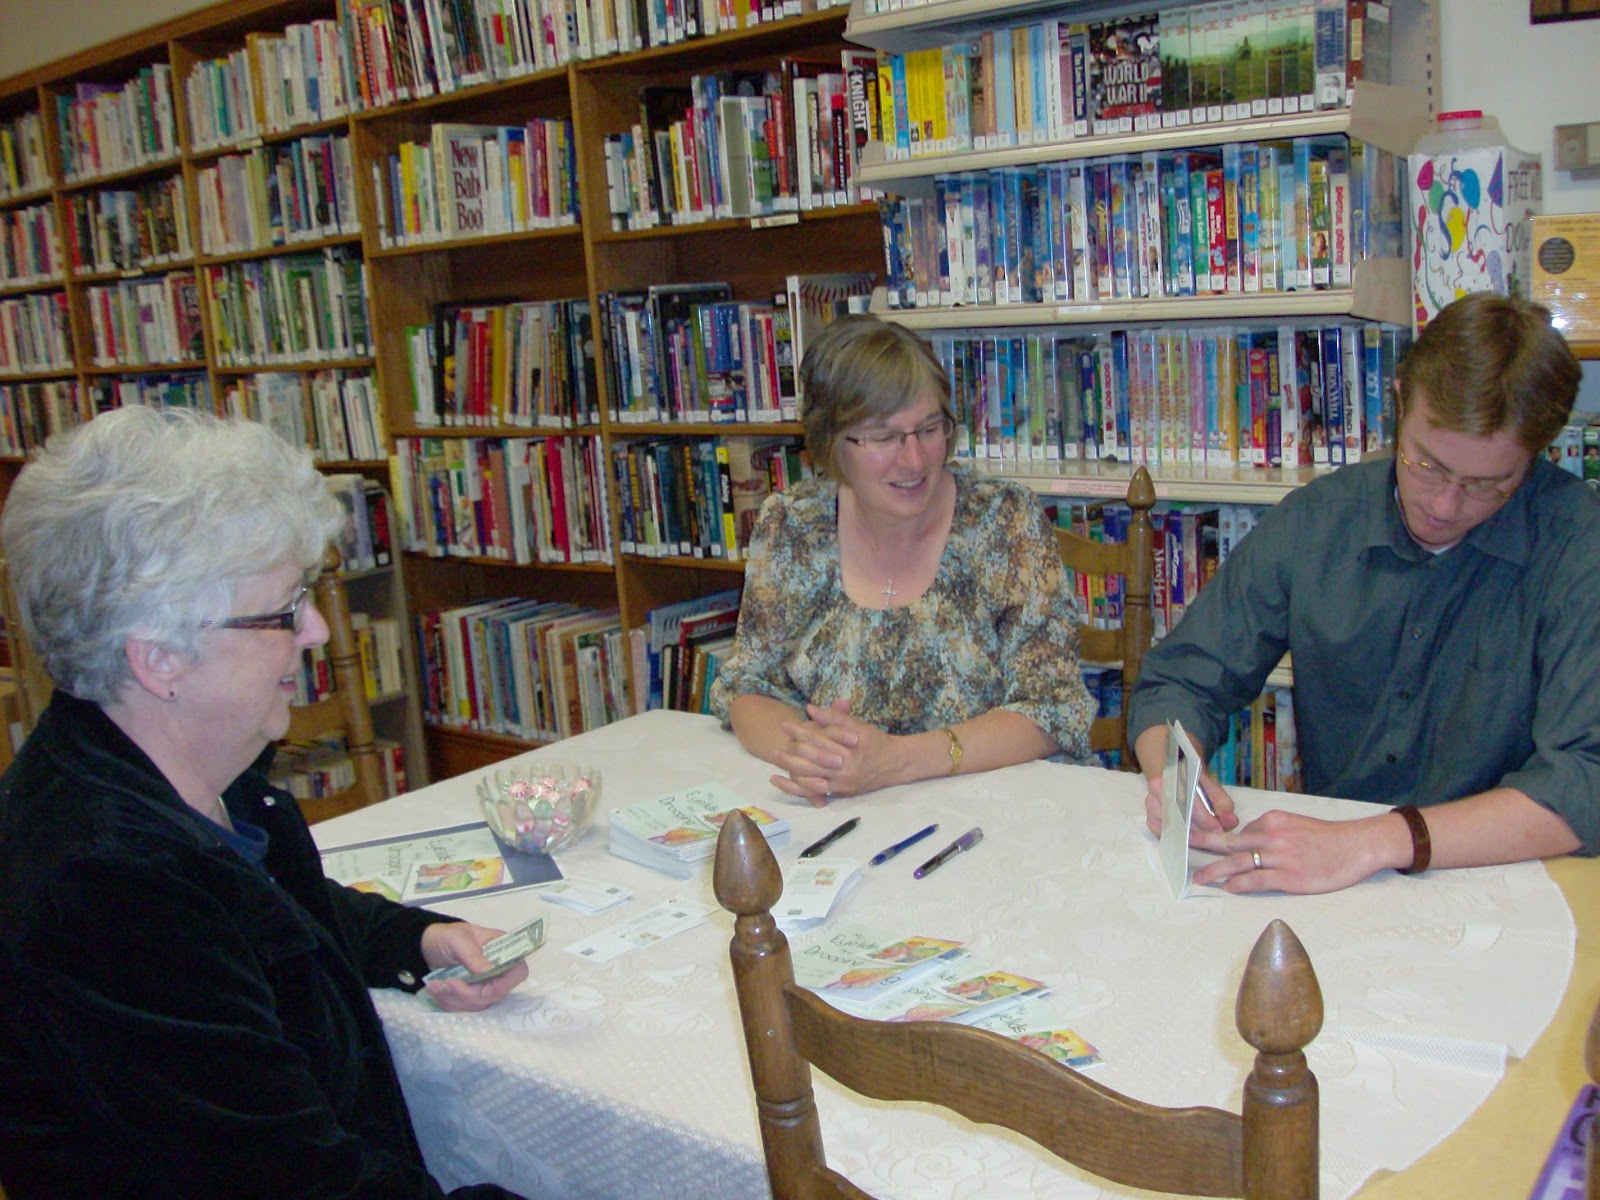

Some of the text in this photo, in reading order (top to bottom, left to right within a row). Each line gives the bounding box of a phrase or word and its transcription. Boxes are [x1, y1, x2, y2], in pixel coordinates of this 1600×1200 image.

[1104, 62, 1149, 84] WORLD
[851, 74, 867, 130] KNIGHT
[1107, 83, 1137, 105] WAR
[450, 140, 478, 168] New
[453, 171, 482, 199] Bab
[456, 201, 484, 231] Boo
[701, 309, 712, 347] CHICAGO
[1103, 362, 1111, 388] GOOD
[1328, 363, 1340, 420] IRON WILL
[720, 474, 730, 503] Fishing
